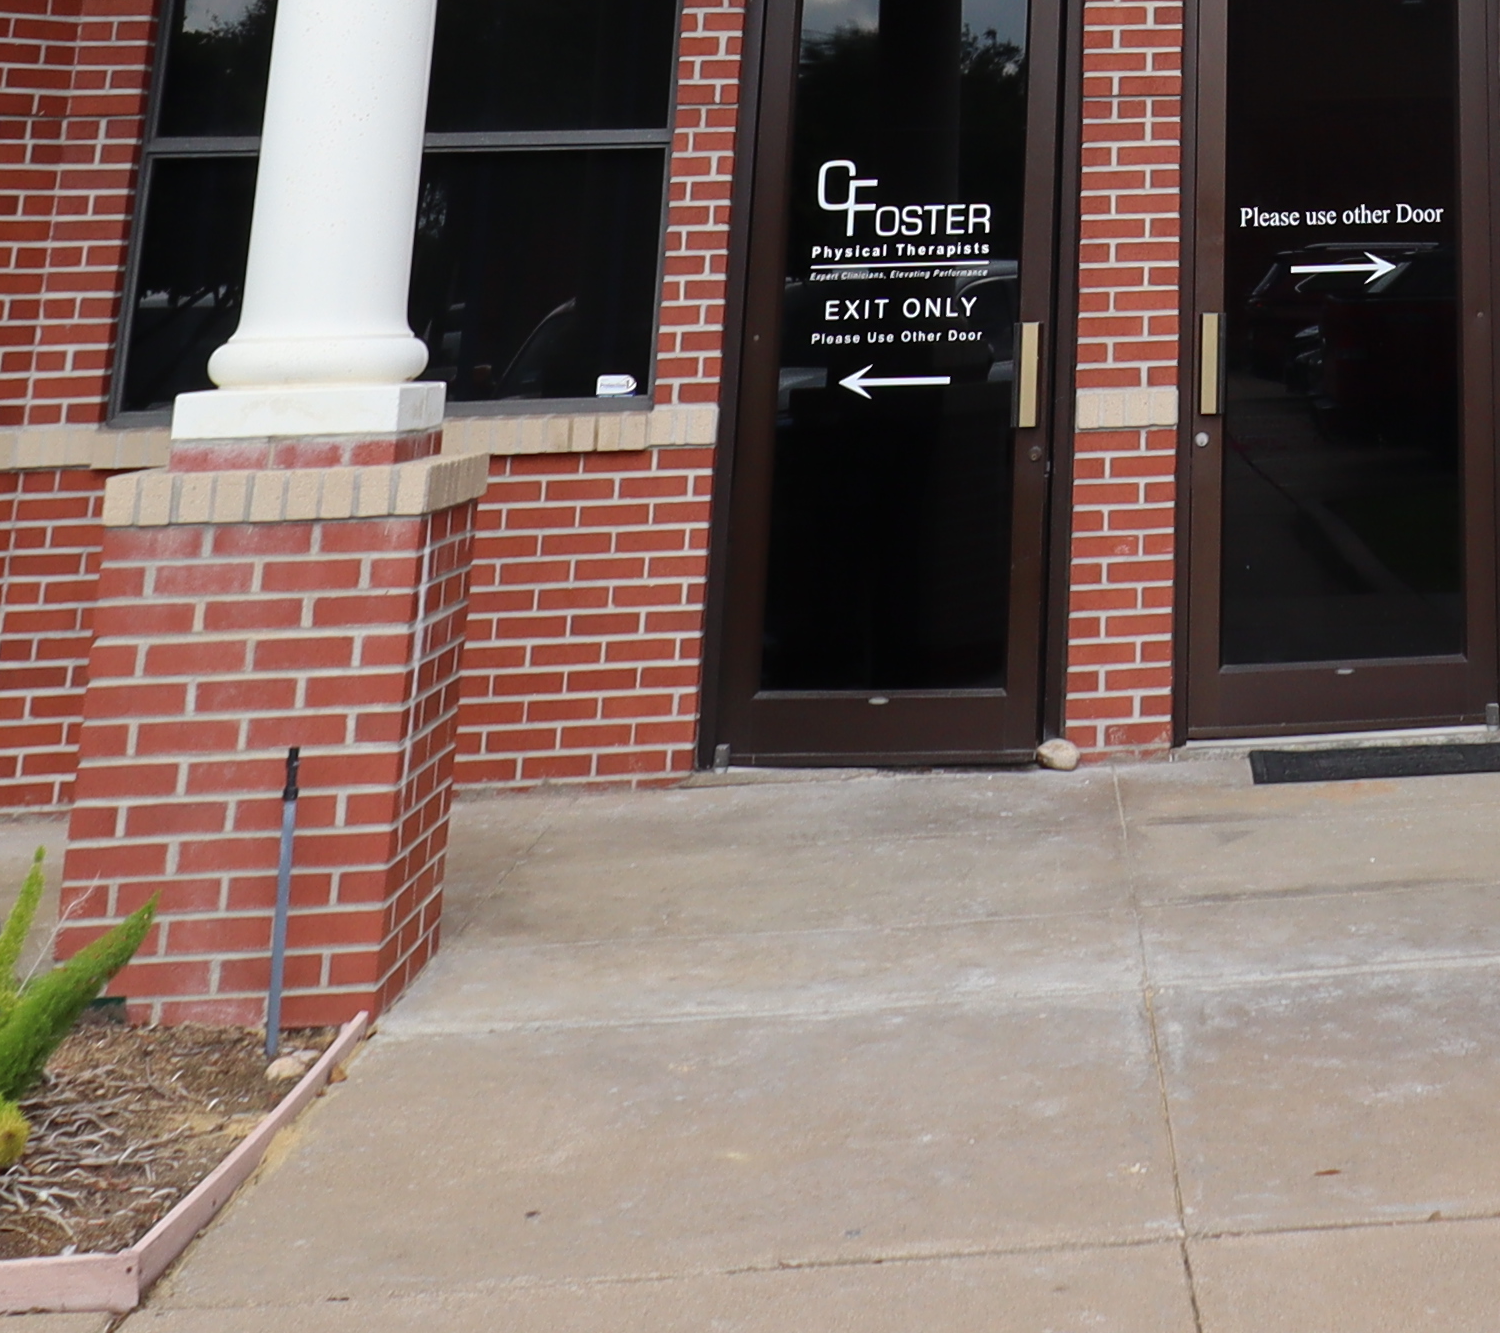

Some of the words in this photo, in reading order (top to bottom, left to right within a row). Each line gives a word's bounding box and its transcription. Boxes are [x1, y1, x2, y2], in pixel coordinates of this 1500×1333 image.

[1239, 206, 1301, 228] Please
[1305, 210, 1337, 226] use
[1342, 204, 1391, 224] other
[1396, 203, 1445, 224] Door
[811, 244, 888, 261] Physical
[895, 242, 990, 258] Therapists
[809, 271, 839, 282] Expert
[889, 269, 931, 280] Elevating
[932, 268, 988, 279] Performance
[824, 298, 890, 321] EXIT
[902, 296, 978, 319] ONLY
[811, 333, 861, 345] Please
[867, 331, 895, 344] Use
[900, 330, 942, 343] Other
[948, 329, 983, 342] Door
